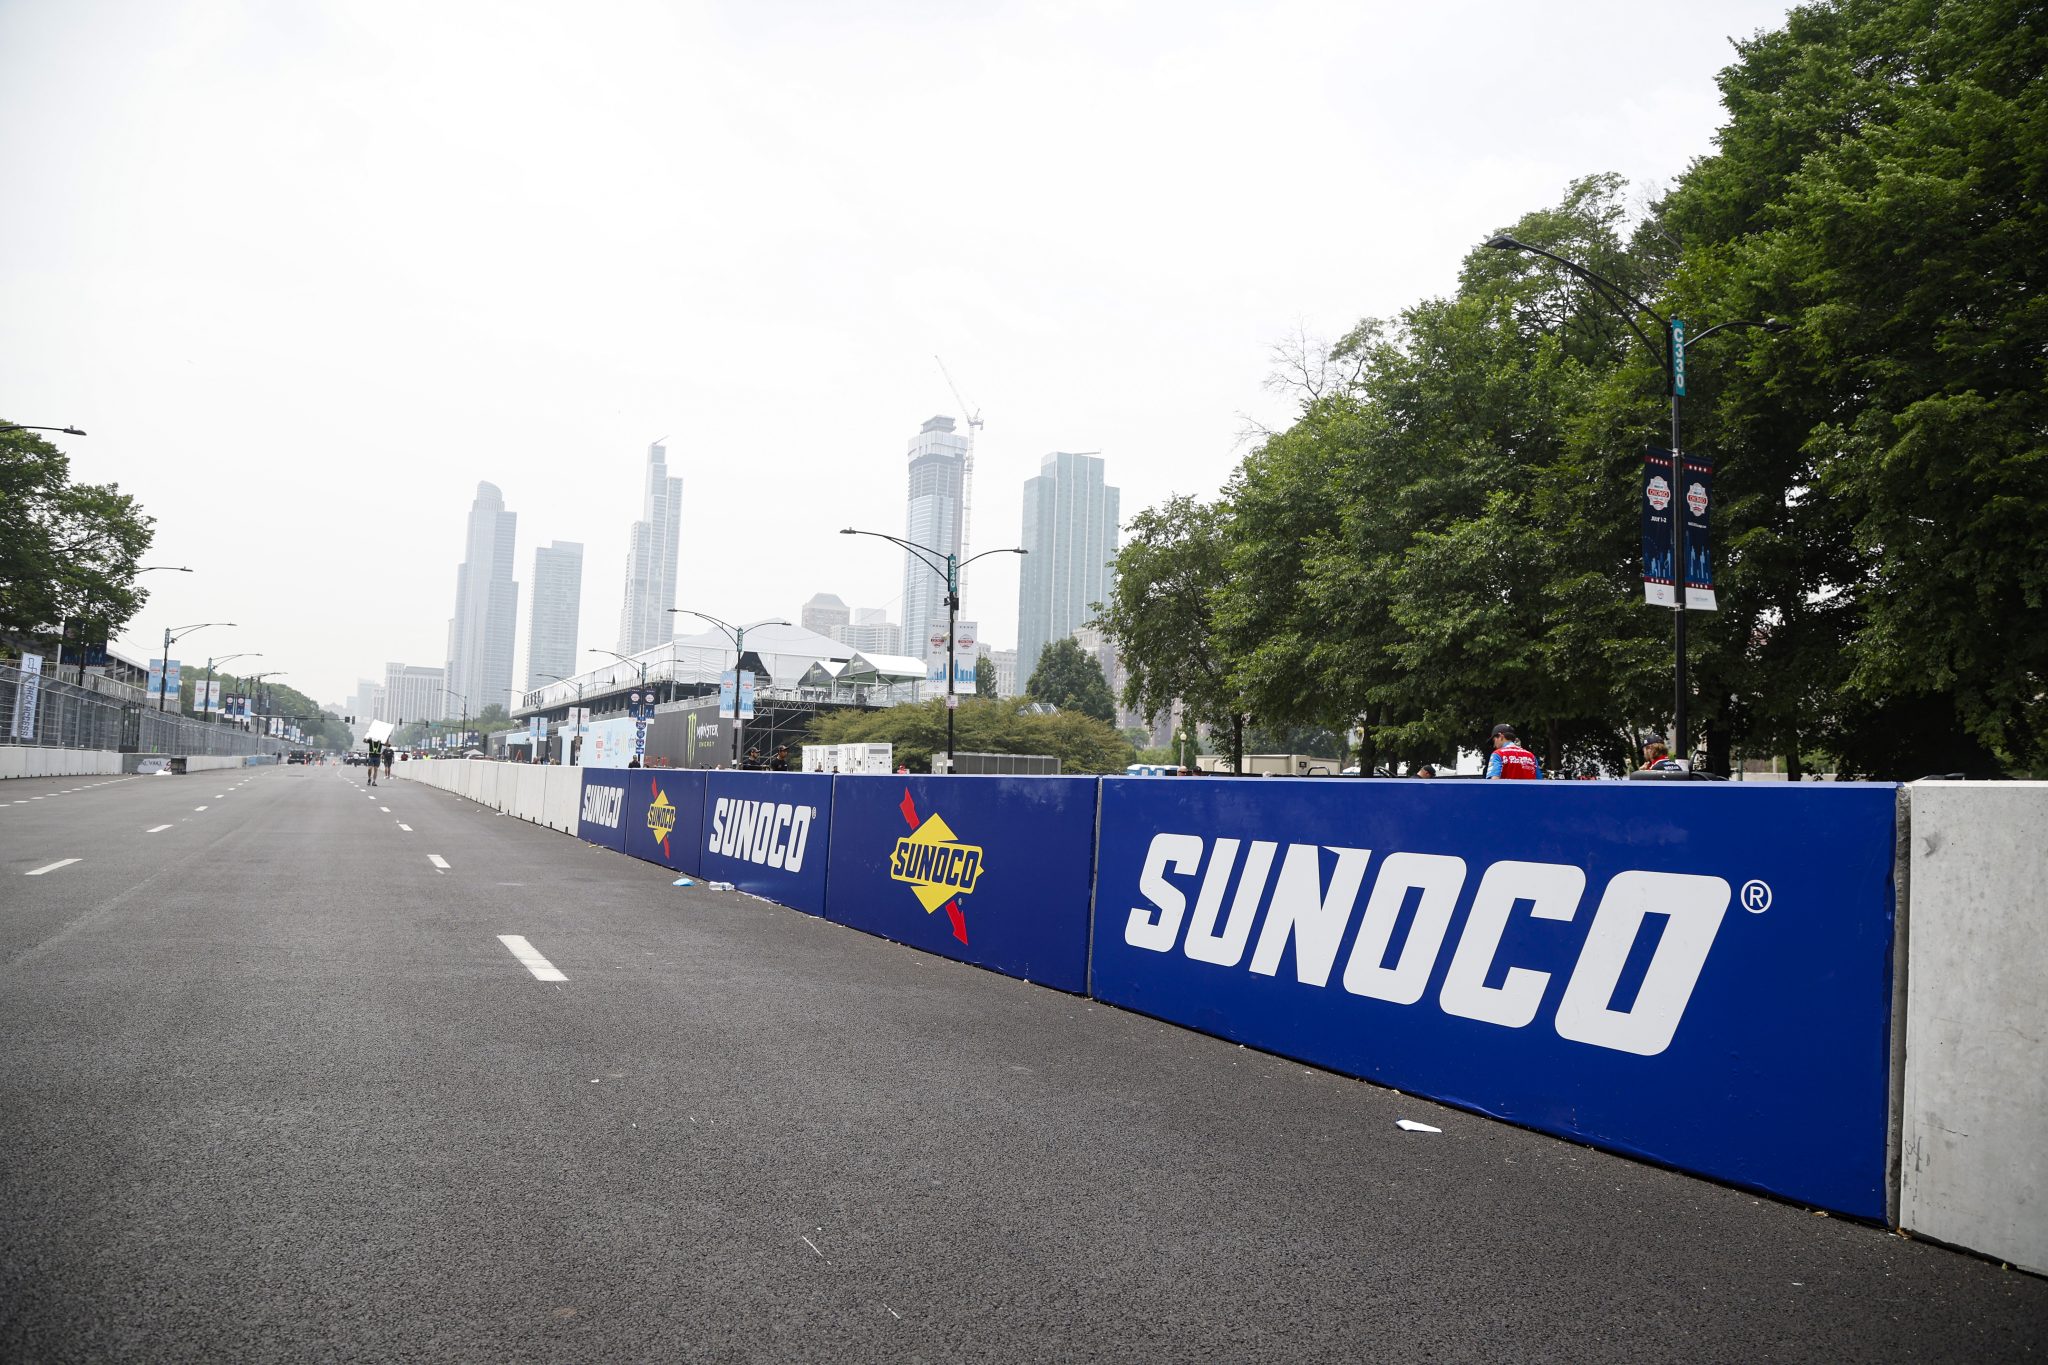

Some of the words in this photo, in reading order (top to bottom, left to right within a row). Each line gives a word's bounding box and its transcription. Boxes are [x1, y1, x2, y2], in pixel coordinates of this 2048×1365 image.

[1673, 327, 1685, 388] C330
[696, 722, 718, 739] MONSTER
[582, 784, 623, 829] SUNOCO
[708, 797, 812, 873] SUNOCO
[892, 841, 980, 889] SUNOCO
[1124, 833, 1732, 1057] SUNOCO
